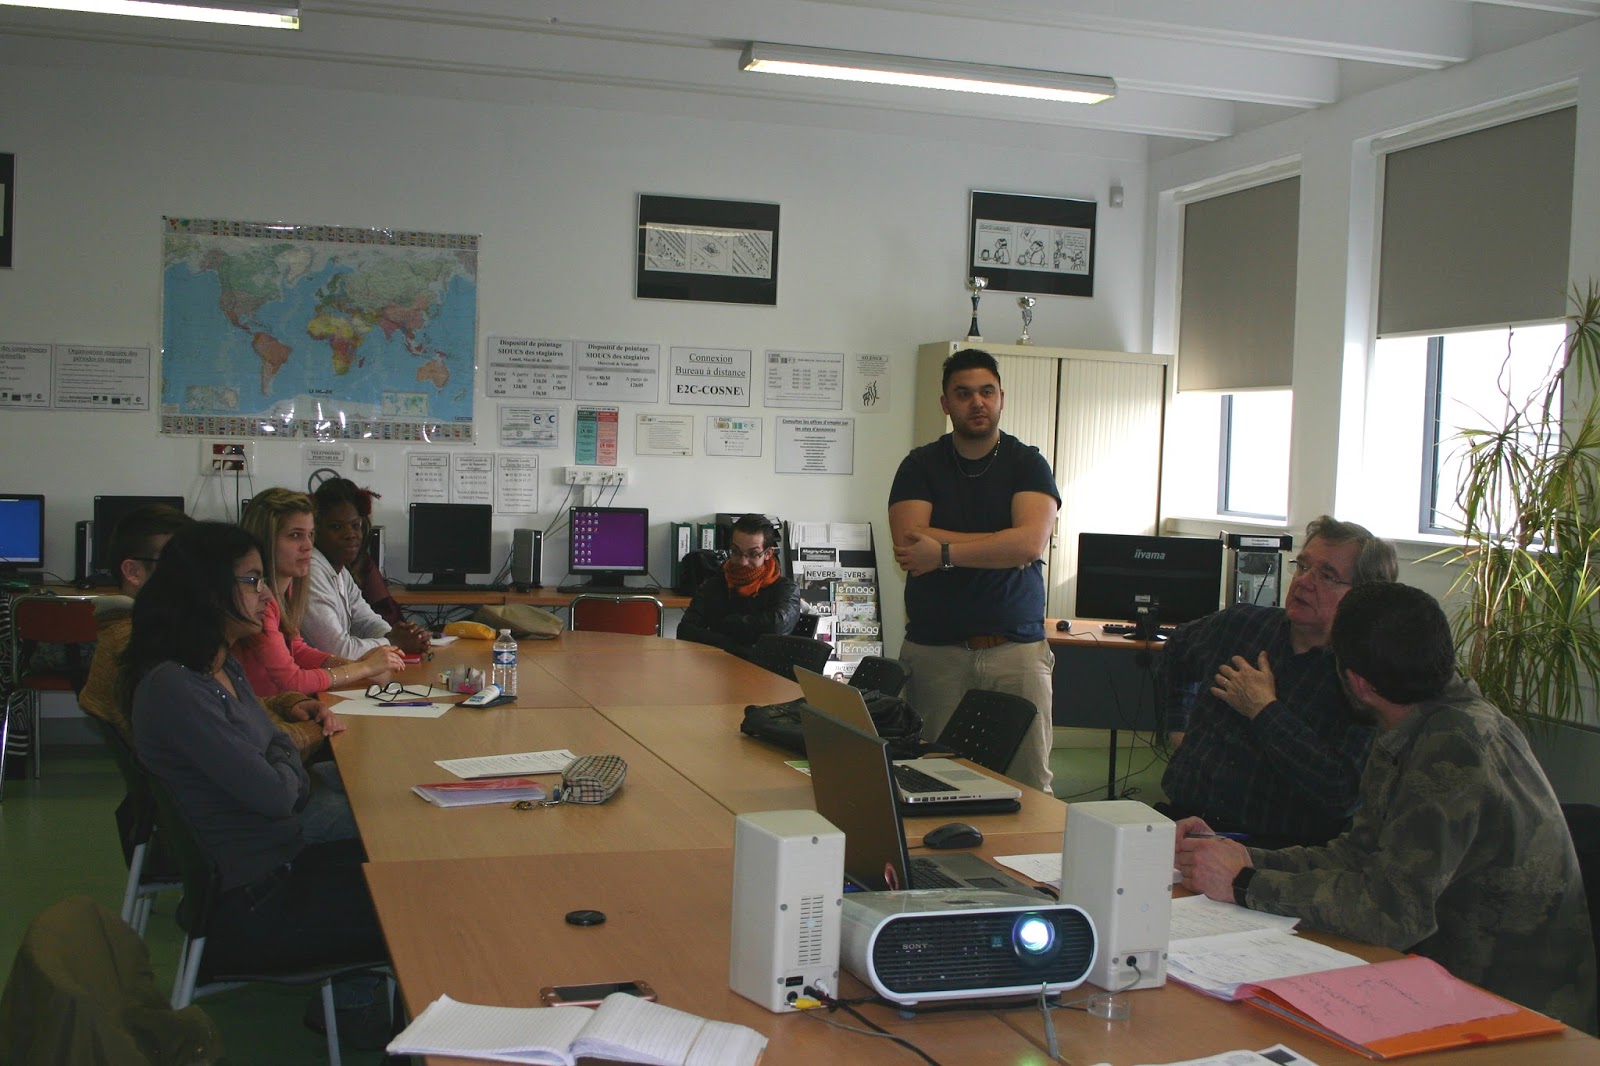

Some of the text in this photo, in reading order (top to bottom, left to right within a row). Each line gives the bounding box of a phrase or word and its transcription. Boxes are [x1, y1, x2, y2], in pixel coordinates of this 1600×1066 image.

[500, 339, 528, 347] Dispositif
[689, 352, 733, 364] Connexion
[675, 366, 746, 378] Bureau à distance
[1134, 549, 1166, 560] iiyama
